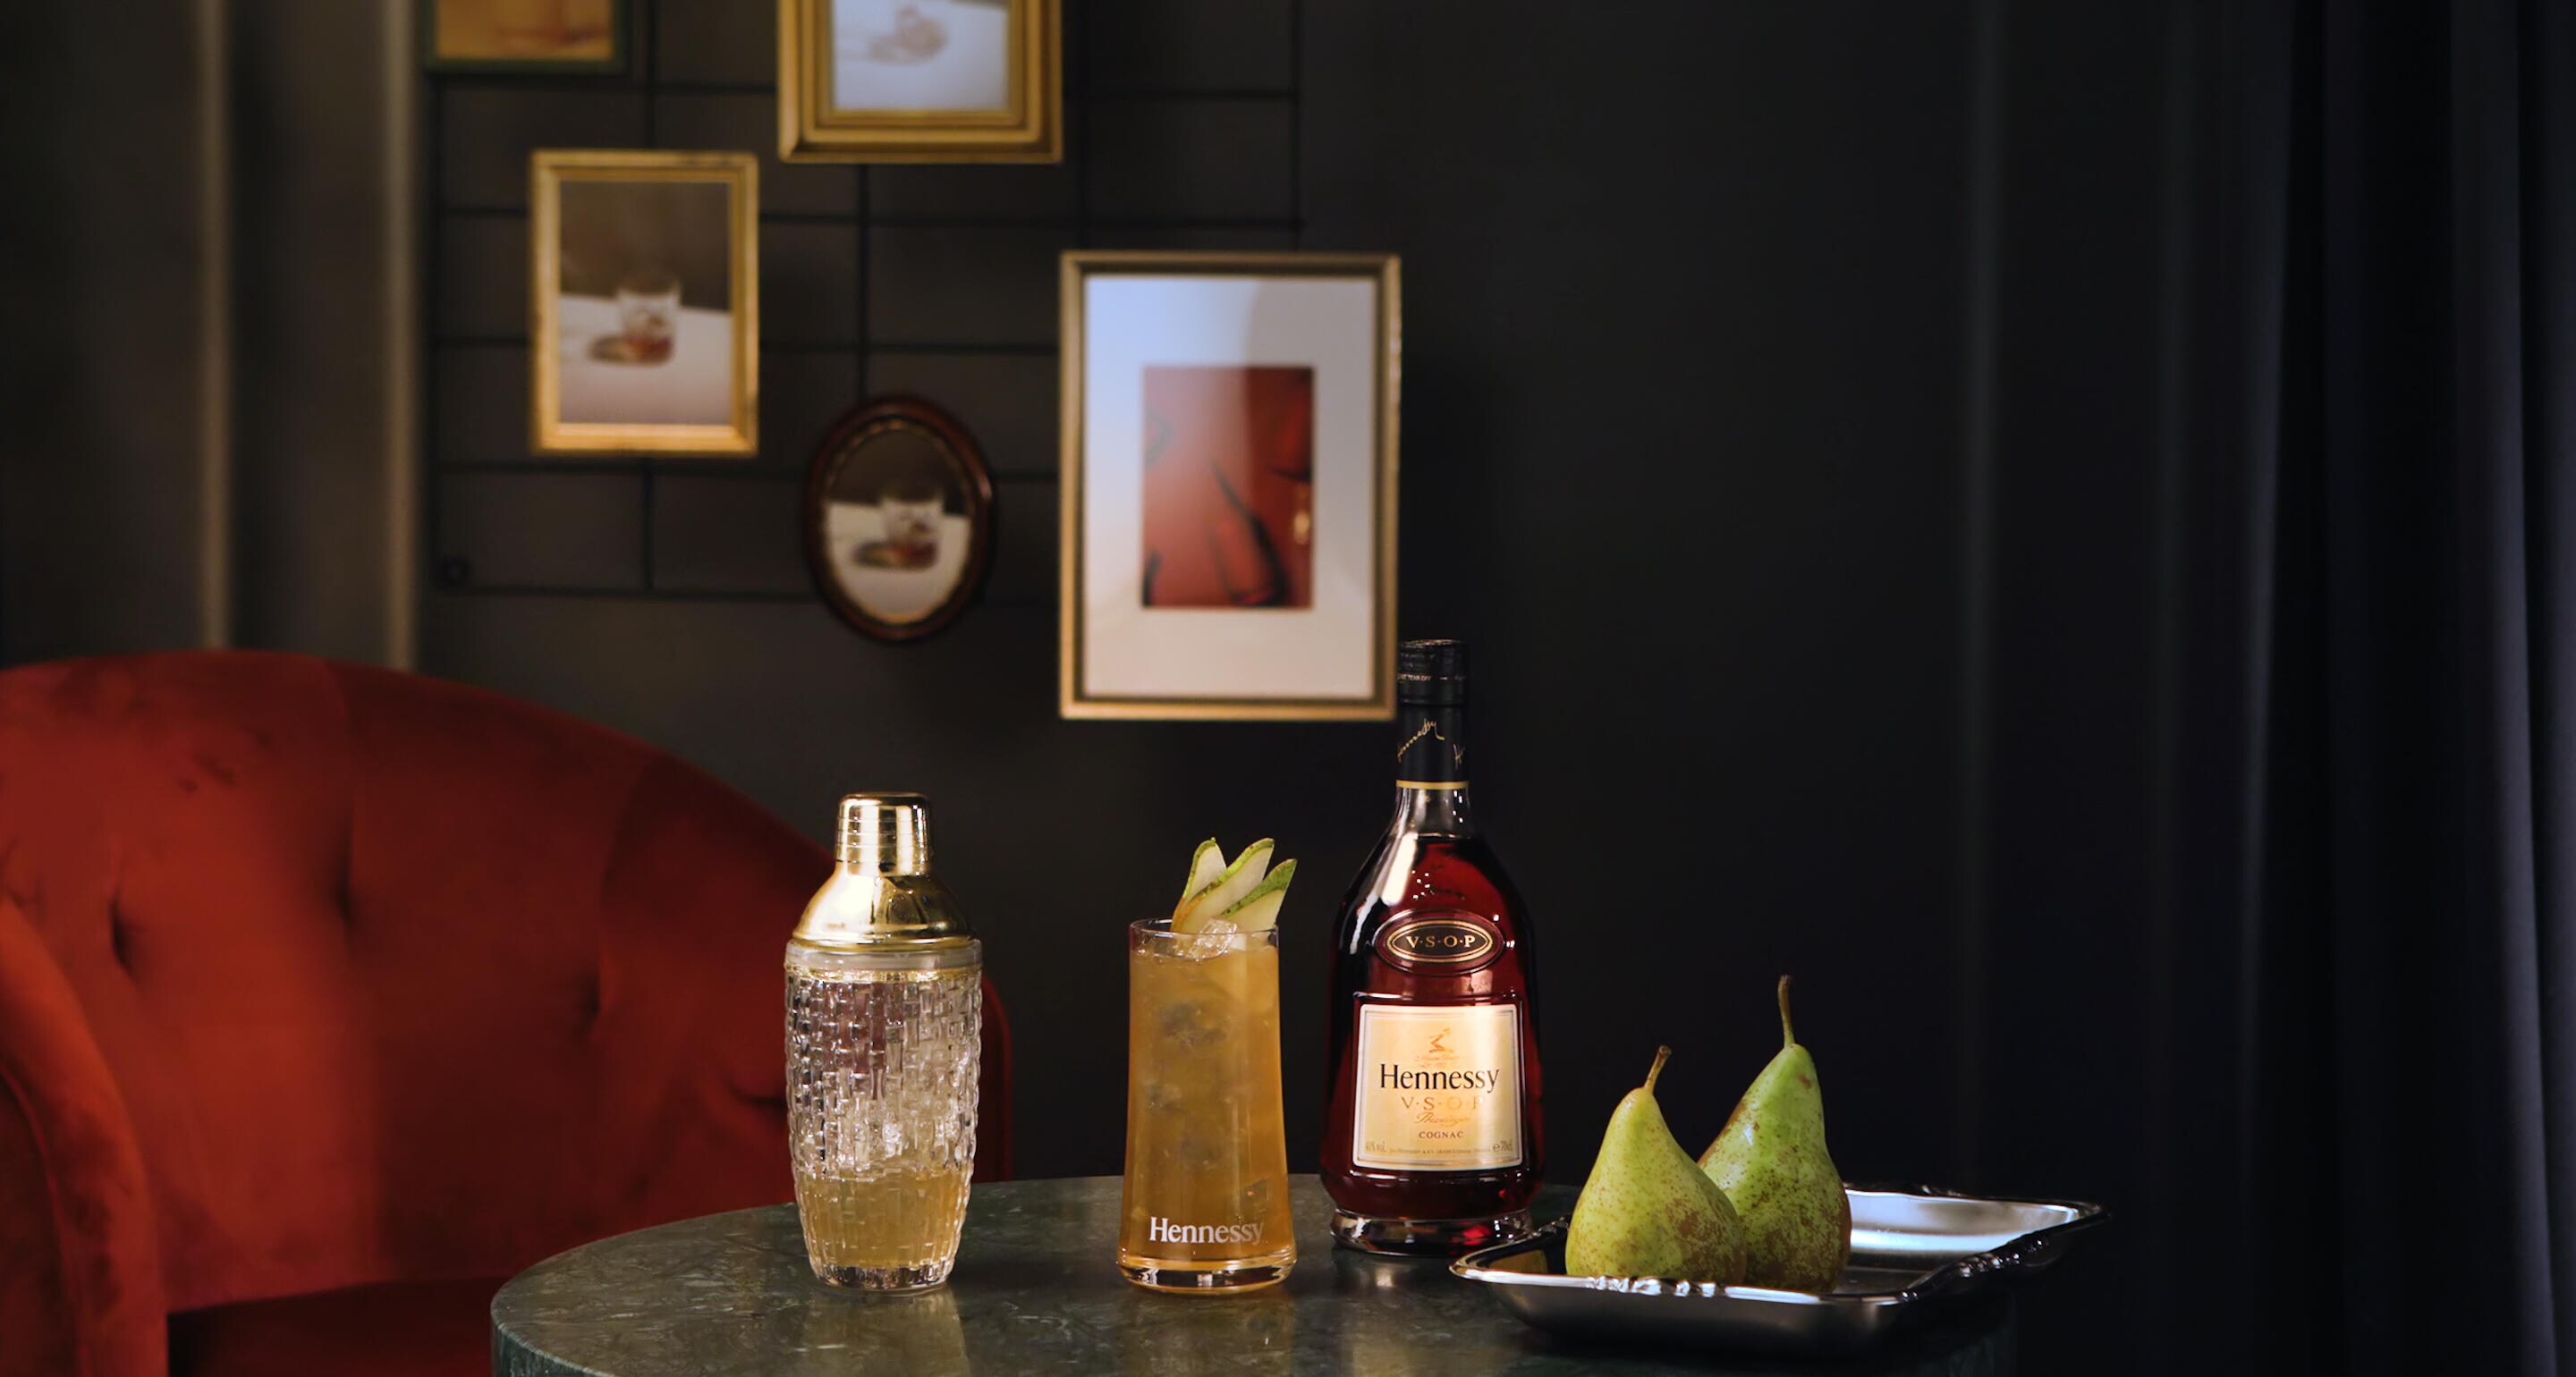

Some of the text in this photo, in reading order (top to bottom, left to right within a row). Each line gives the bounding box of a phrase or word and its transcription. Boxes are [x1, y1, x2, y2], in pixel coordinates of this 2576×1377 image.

[1380, 1063, 1500, 1094] Hennessy
[1419, 1130, 1464, 1139] COGNAC
[1149, 1216, 1264, 1246] Hennessy
